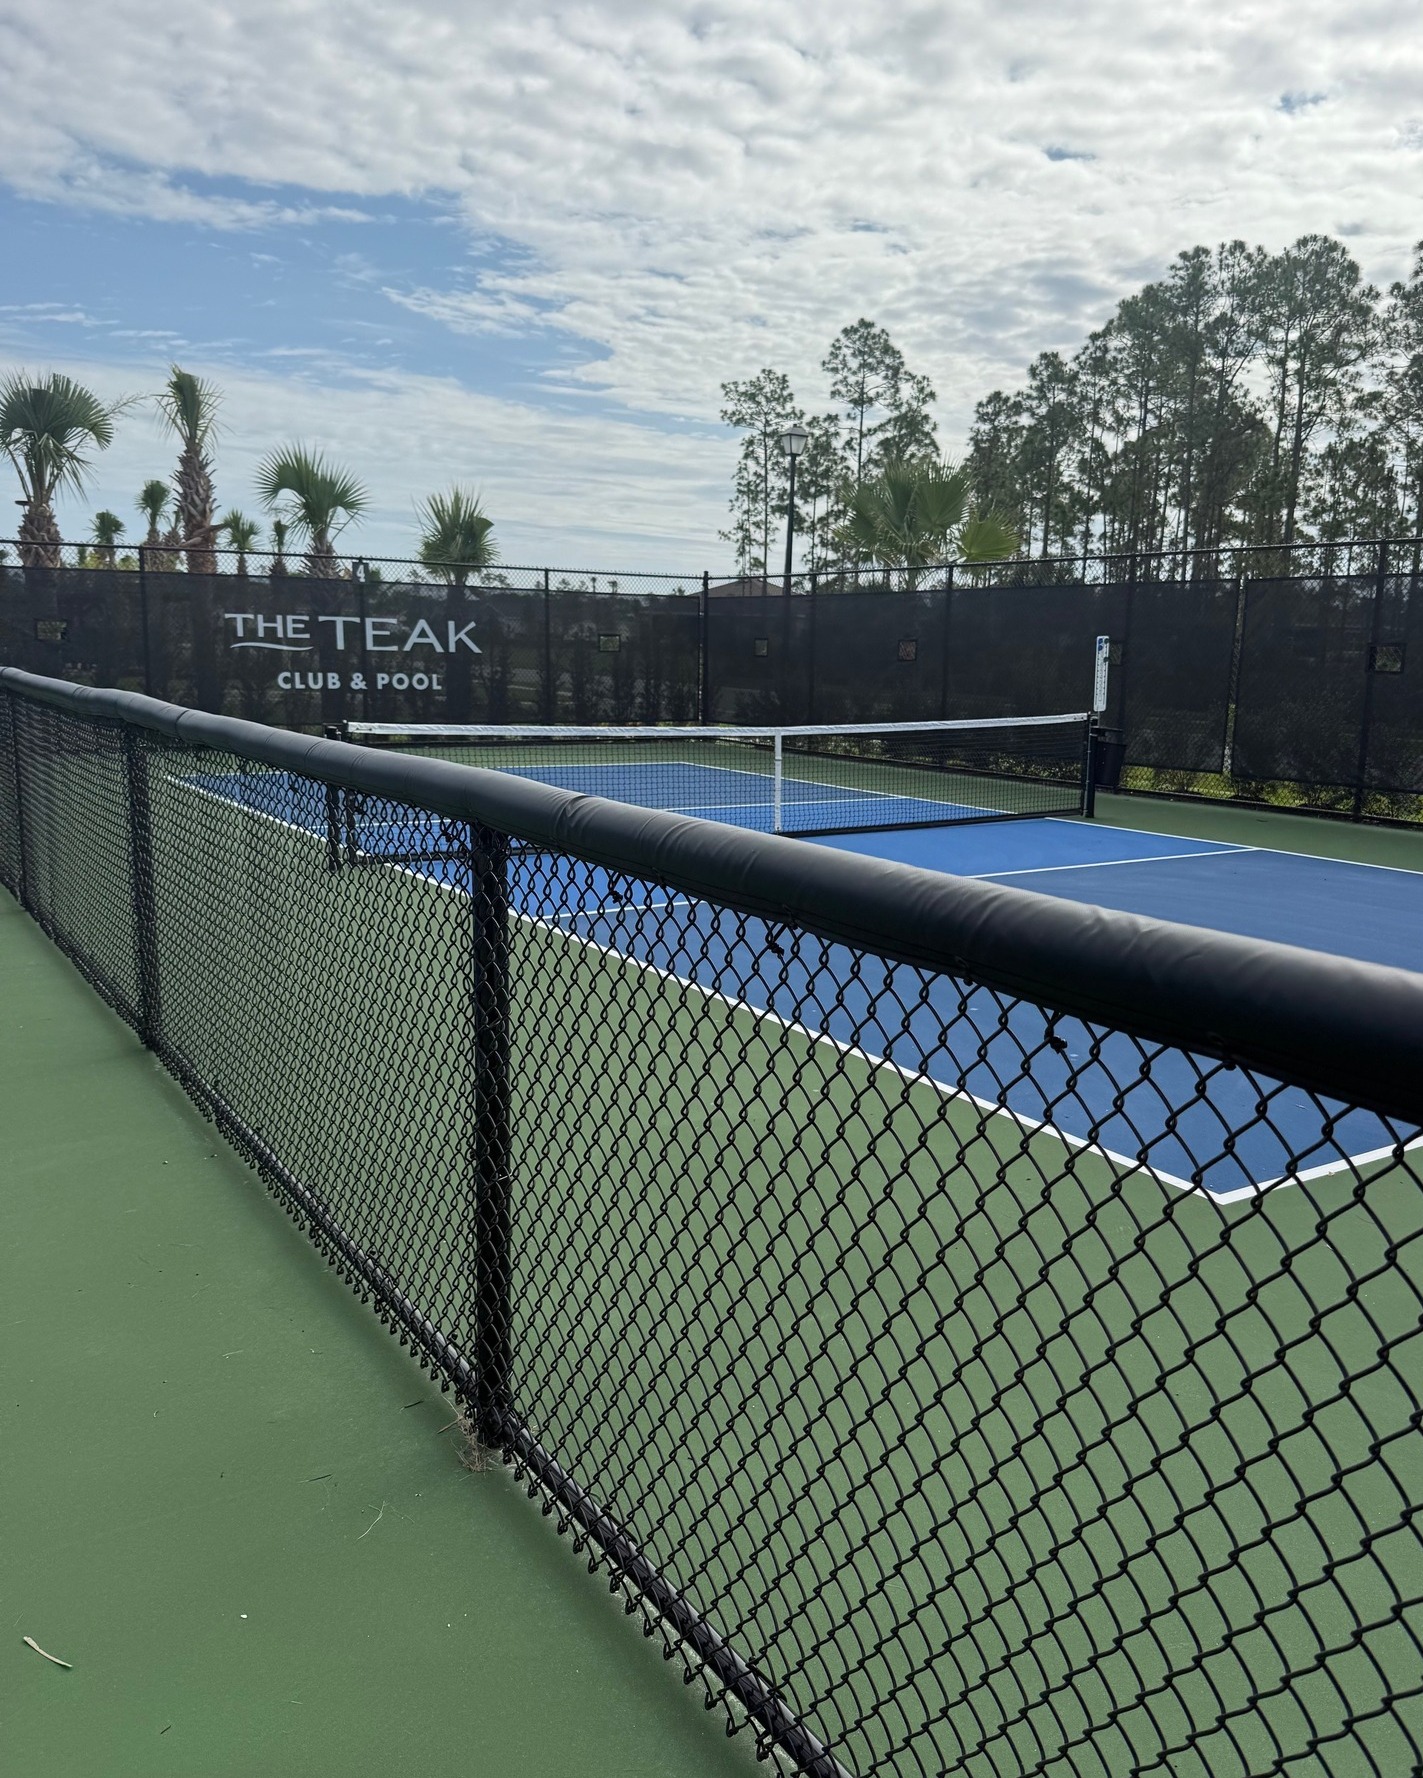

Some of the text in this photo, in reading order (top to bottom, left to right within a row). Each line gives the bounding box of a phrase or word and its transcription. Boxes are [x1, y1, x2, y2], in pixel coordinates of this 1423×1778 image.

[356, 564, 366, 582] 4
[224, 613, 482, 654] THE TEAK
[277, 671, 442, 690] CLUB & POOL
